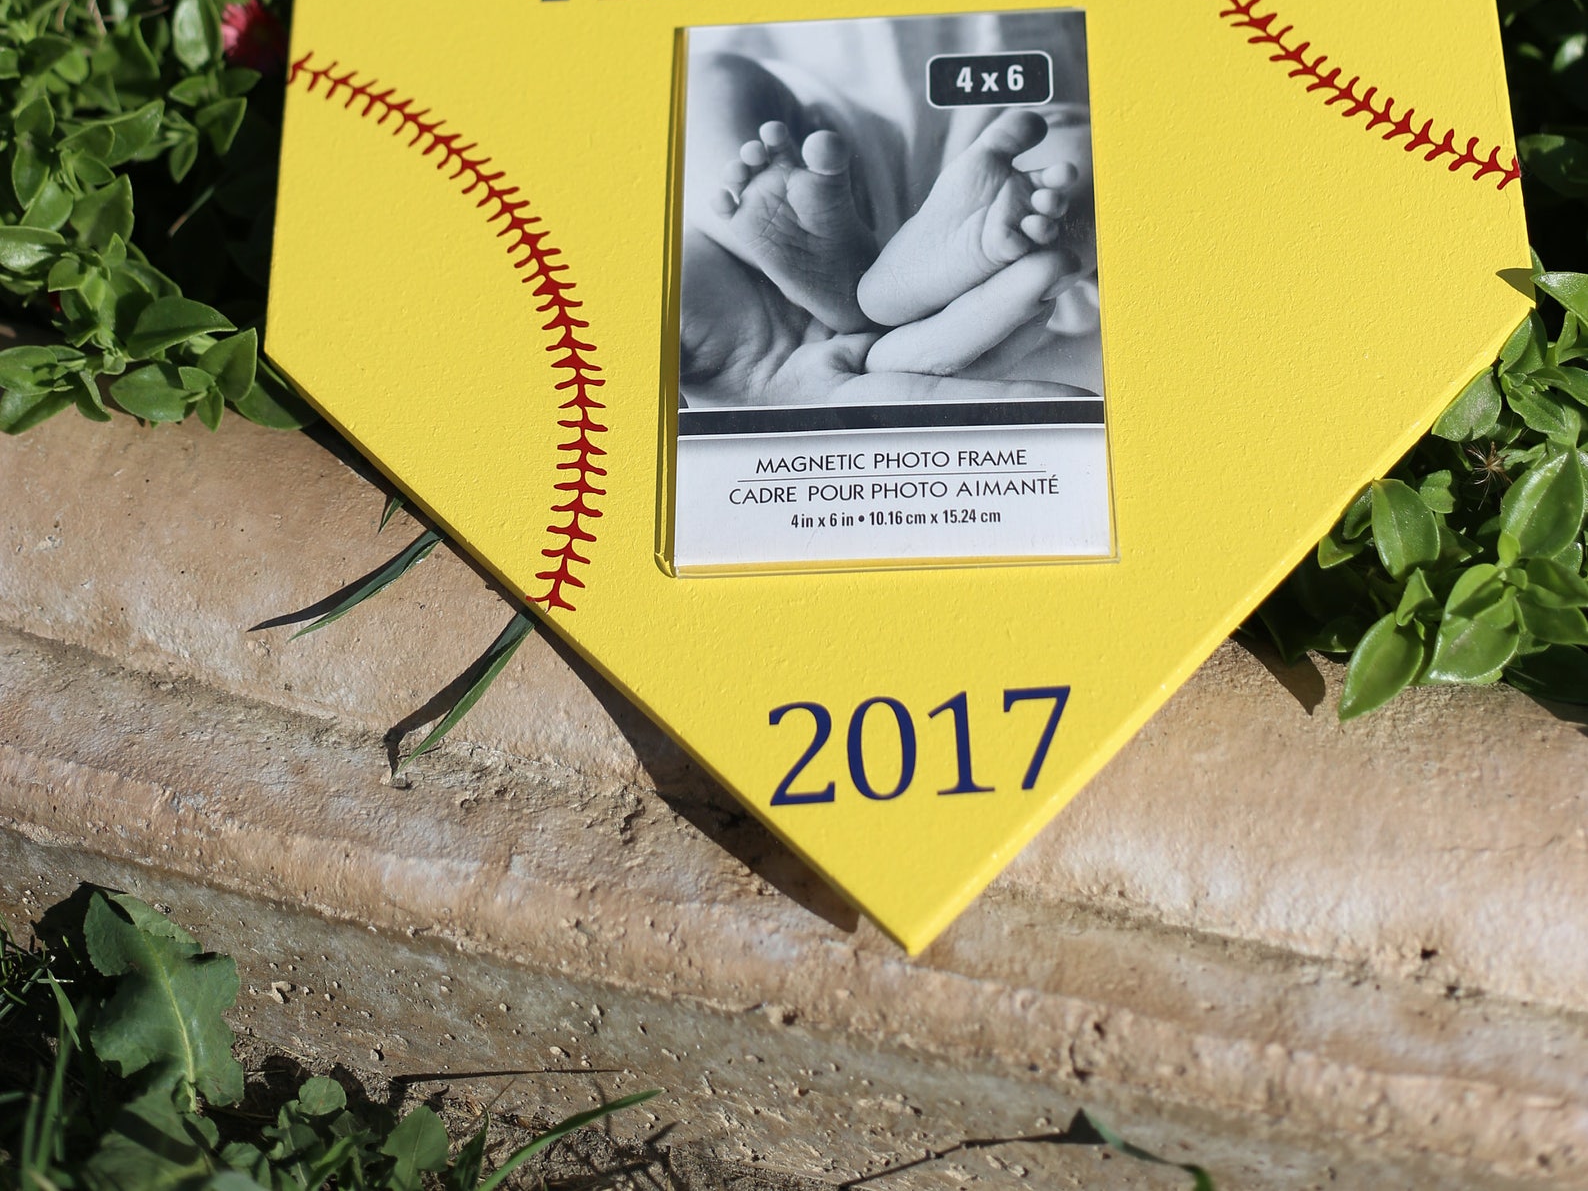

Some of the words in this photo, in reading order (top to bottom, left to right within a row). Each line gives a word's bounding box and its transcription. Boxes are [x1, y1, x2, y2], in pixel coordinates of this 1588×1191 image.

[956, 66, 974, 93] 4
[1006, 64, 1025, 91] 6
[755, 452, 866, 474] MAGNETIC
[873, 450, 951, 469] PHOTO
[957, 449, 1028, 467] FRAME
[728, 484, 798, 505] CADRE
[808, 483, 865, 502] POUR
[871, 481, 948, 500] PHOTO
[955, 474, 1060, 498] AIMANTÉ
[817, 516, 826, 528] x
[829, 512, 838, 527] 6
[841, 511, 854, 527] in
[869, 510, 903, 526] 10.16
[905, 512, 927, 525] cm
[930, 513, 939, 524] x
[942, 508, 977, 524] 15.24
[980, 510, 1001, 523] cm
[768, 684, 1071, 807] 2017
